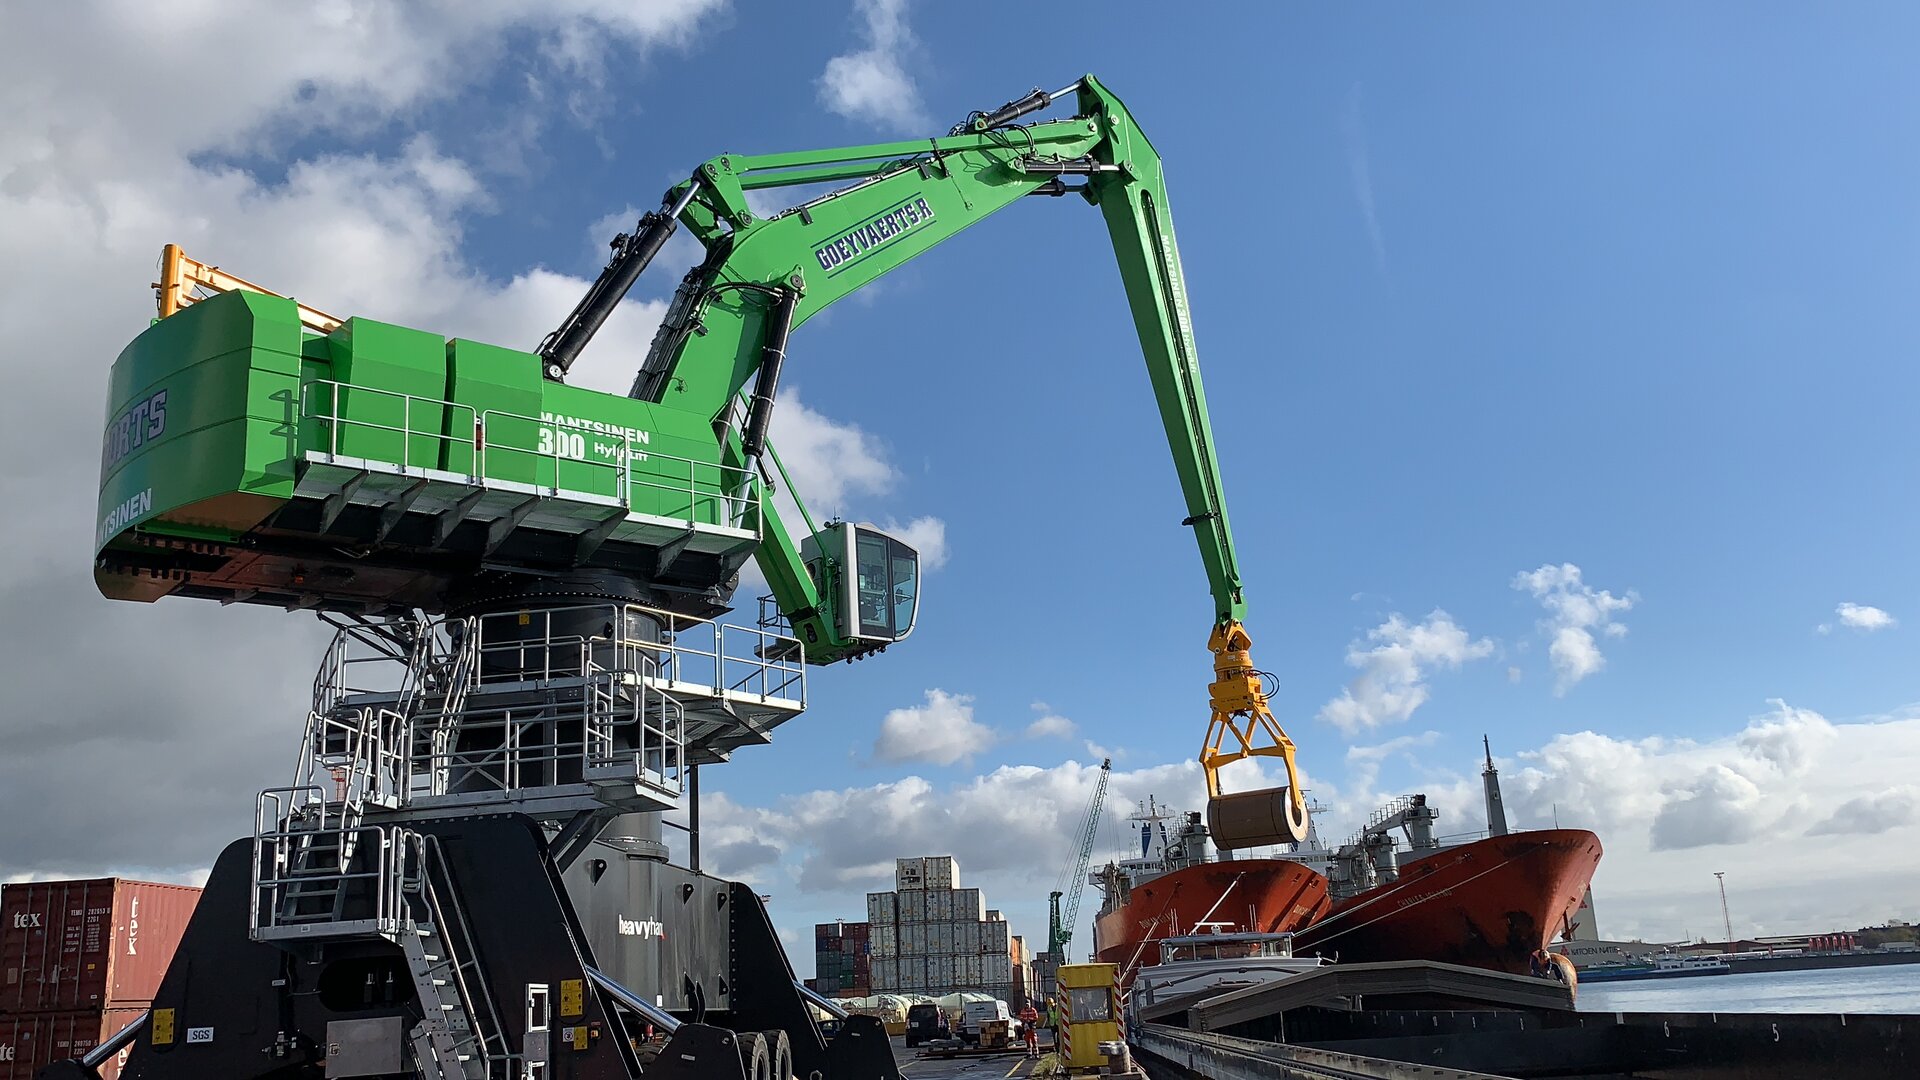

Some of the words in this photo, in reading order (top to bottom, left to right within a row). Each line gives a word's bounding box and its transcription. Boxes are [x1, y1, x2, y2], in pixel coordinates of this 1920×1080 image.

[815, 197, 935, 271] GOEYVAERTS-R
[1161, 234, 1184, 308] MANTSINEN
[1177, 307, 1189, 333] 300
[537, 427, 585, 461] 300
[540, 411, 649, 445] MANTSINEN
[13, 910, 42, 928] tex
[127, 896, 139, 955] tex
[192, 1029, 211, 1041] SGS
[1663, 1021, 1670, 1038] 6
[1772, 1023, 1779, 1042] 5
